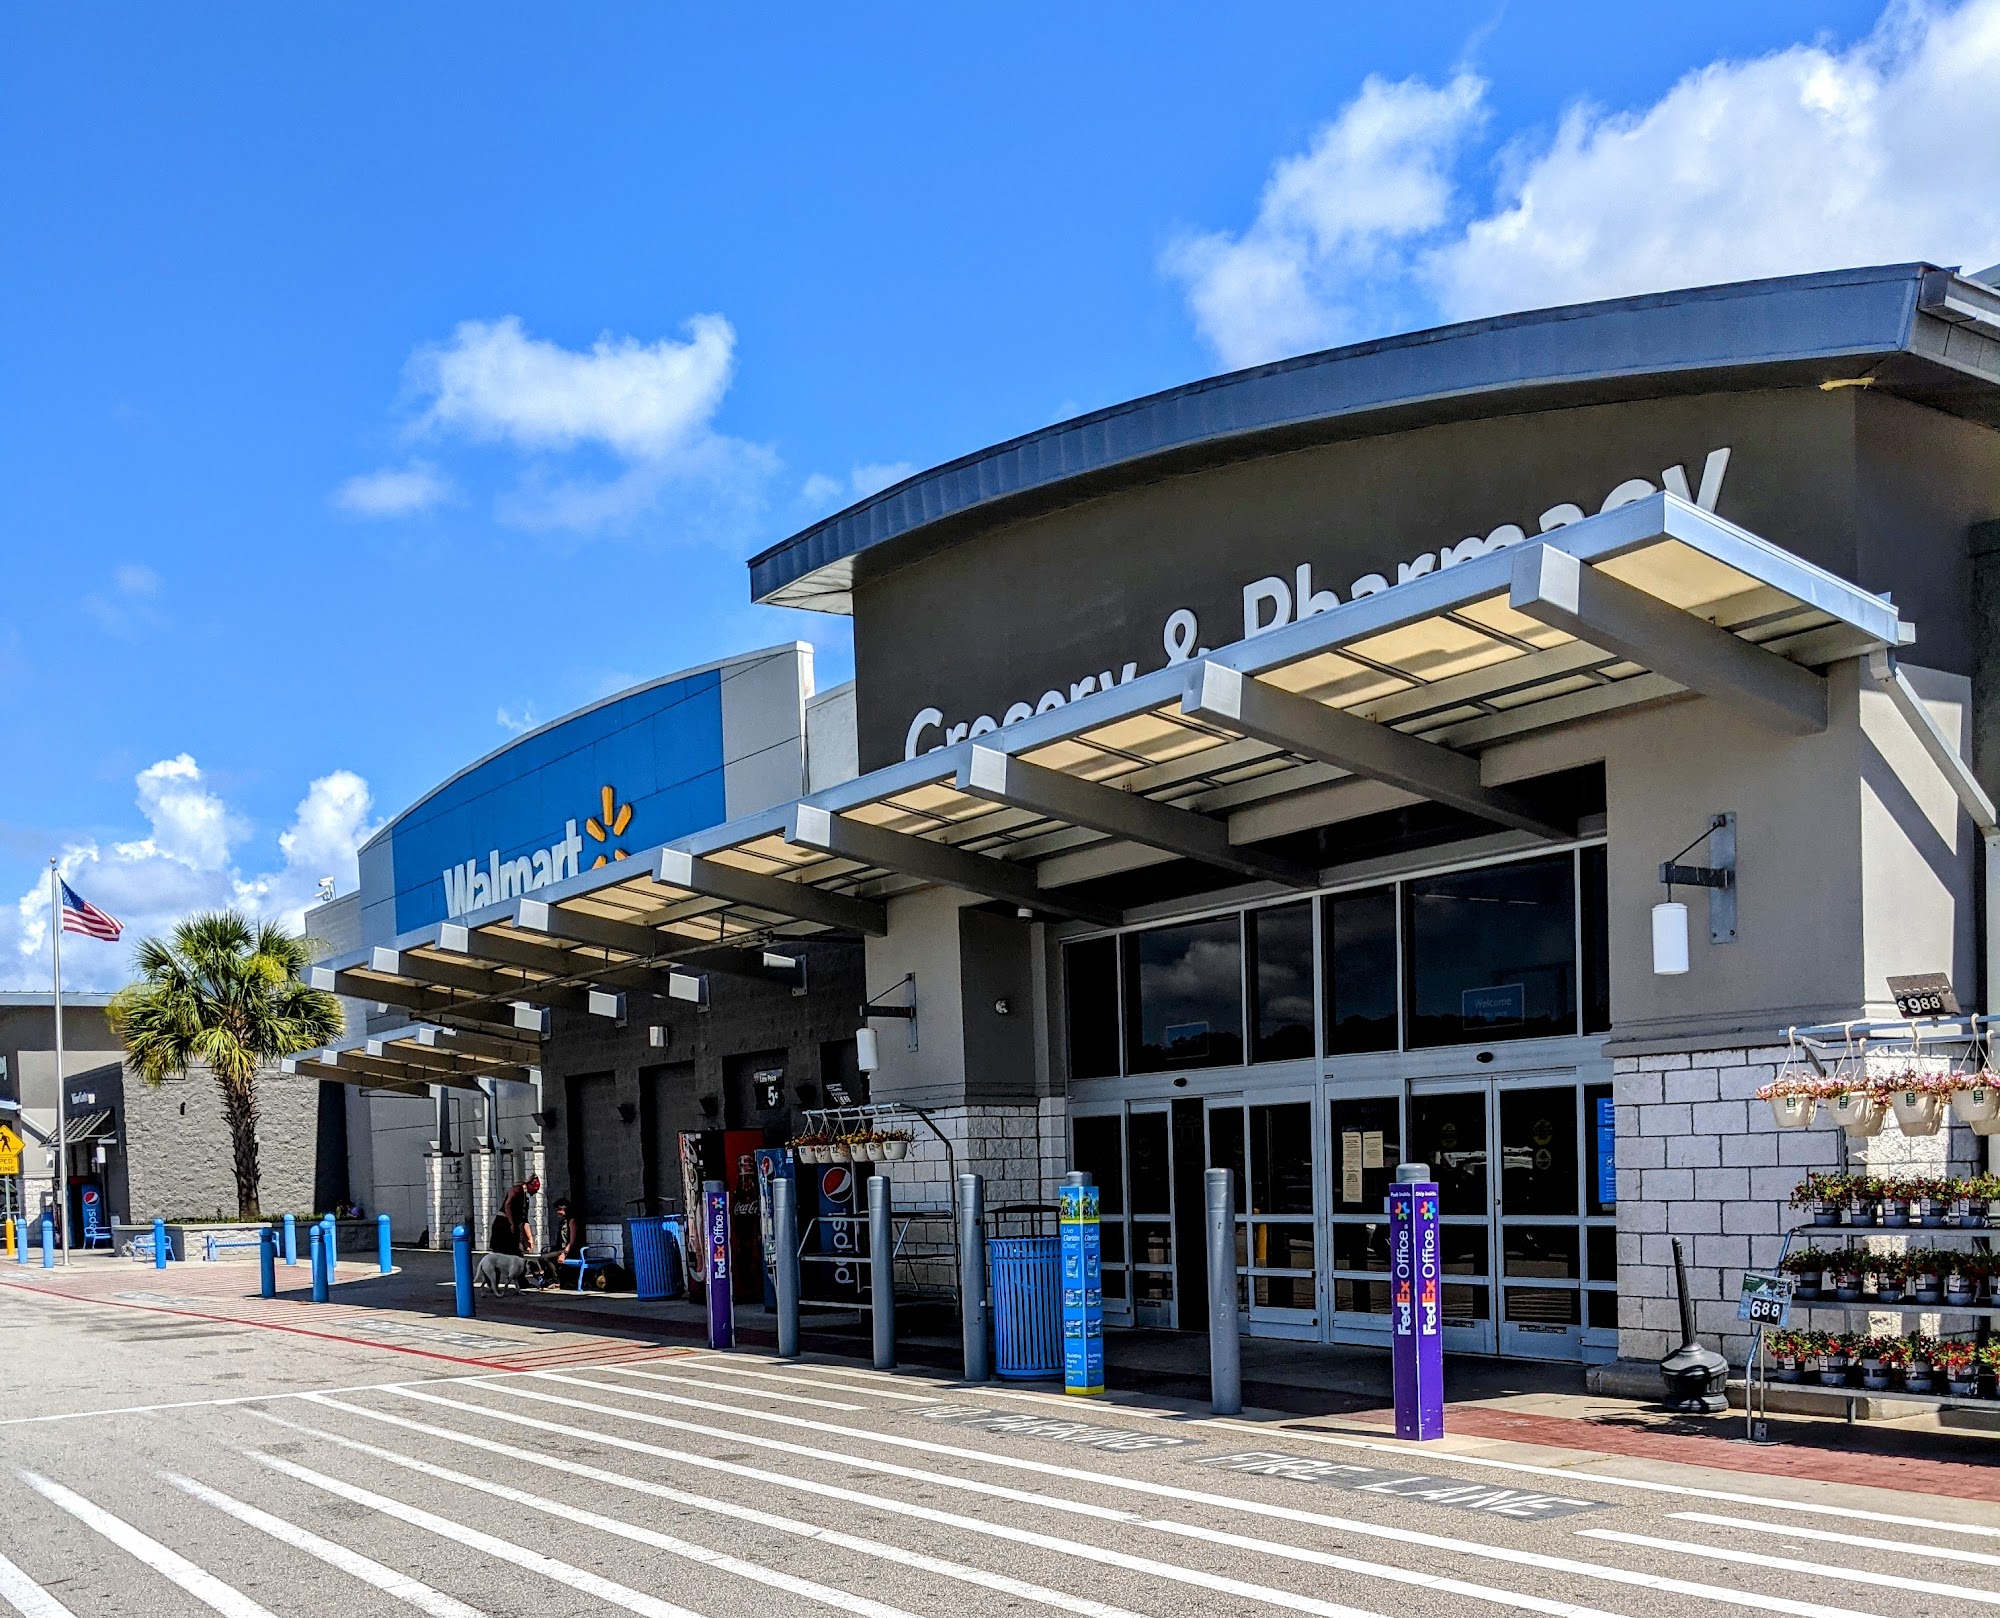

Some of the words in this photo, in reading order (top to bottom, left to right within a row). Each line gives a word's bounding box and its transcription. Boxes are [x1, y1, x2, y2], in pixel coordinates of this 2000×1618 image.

[1163, 608, 1210, 668] &
[443, 819, 583, 919] Walmart
[1063, 1226, 1074, 1234] Live
[714, 1244, 726, 1280] FedEx
[1397, 1280, 1412, 1336] FedEx
[1422, 1279, 1437, 1336] FedEx
[1751, 1301, 1780, 1318] 688
[899, 1403, 993, 1419] NO
[960, 1414, 1185, 1450] PARKING
[1194, 1451, 1375, 1482] FIRE
[1354, 1476, 1596, 1517] LANE
